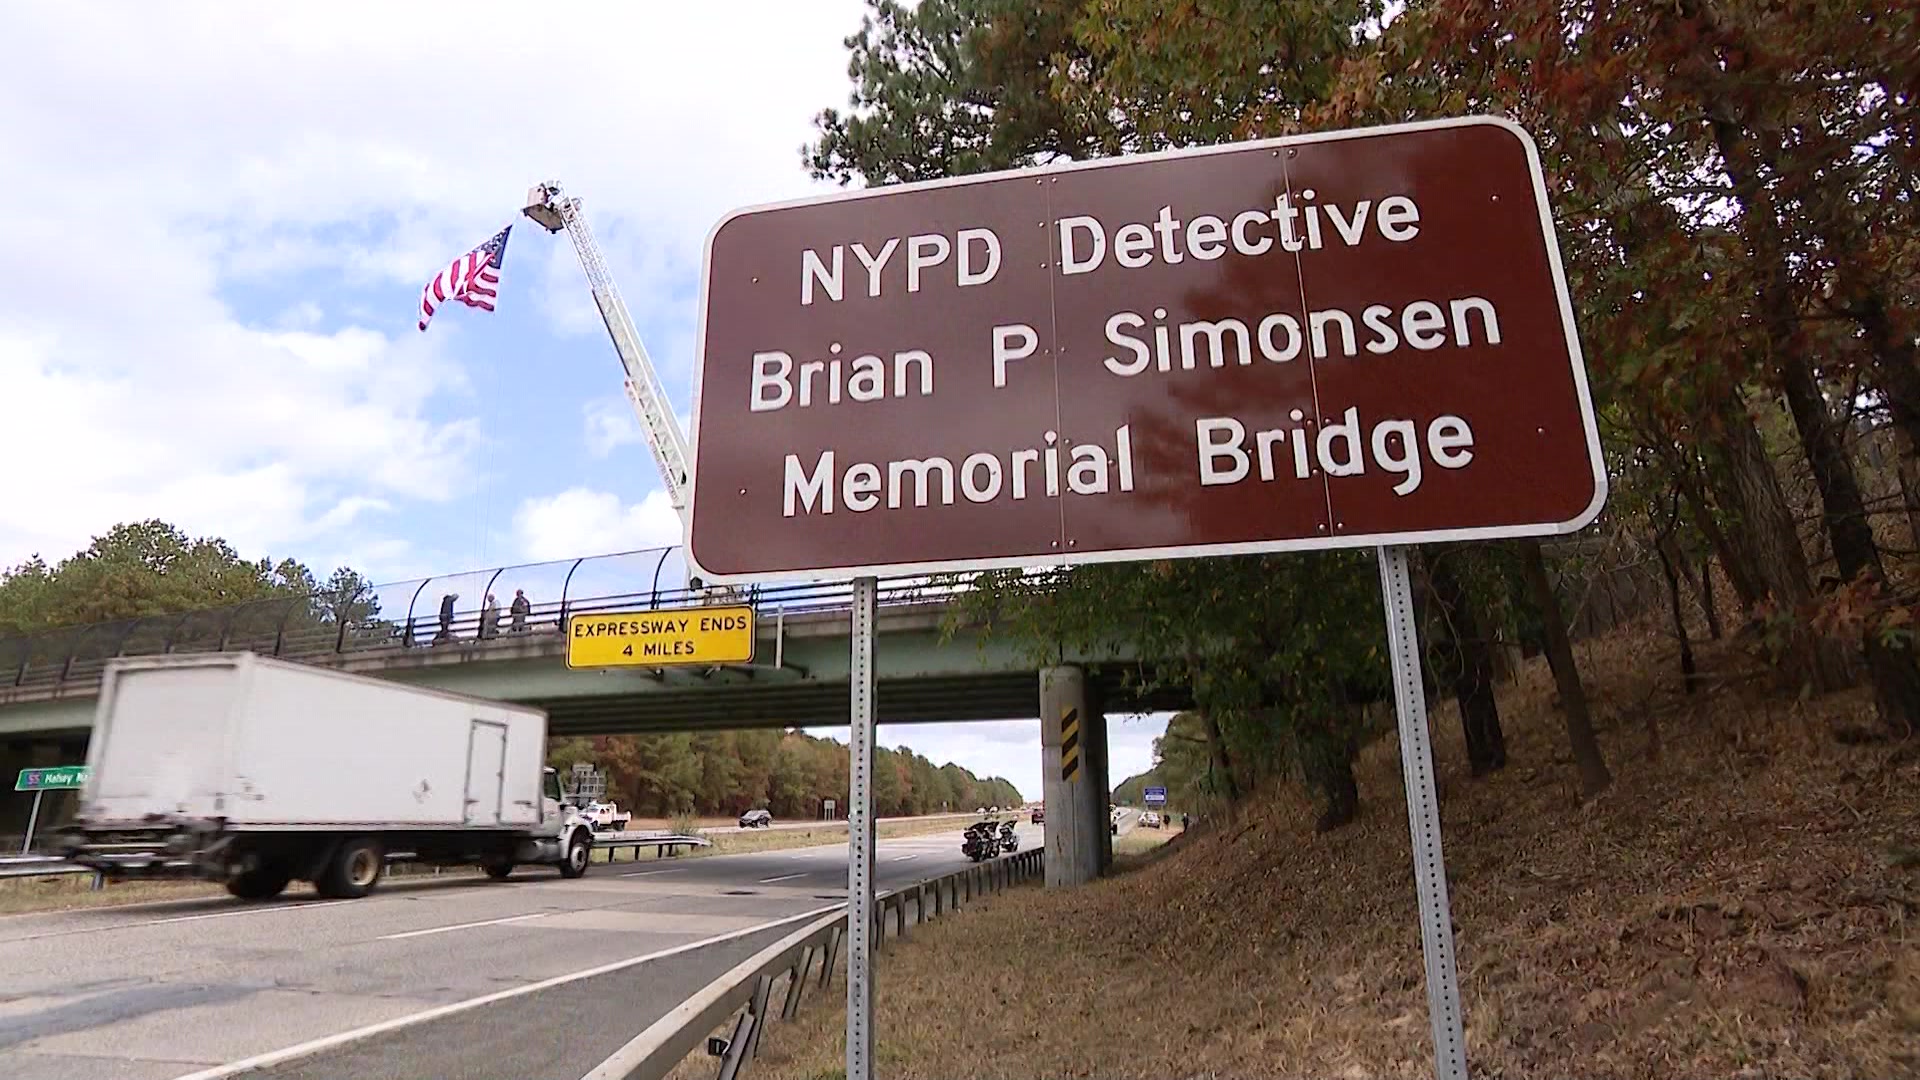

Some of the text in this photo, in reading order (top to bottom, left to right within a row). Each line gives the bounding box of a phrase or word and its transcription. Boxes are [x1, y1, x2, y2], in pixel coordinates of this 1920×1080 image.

[801, 189, 1421, 306] NYPD Detective
[749, 297, 1502, 413] Brian P Simonsen
[782, 406, 1474, 518] Memorial Bridge
[574, 616, 747, 638] EXPRESSWAY ENDS
[622, 641, 695, 657] 4 MILES
